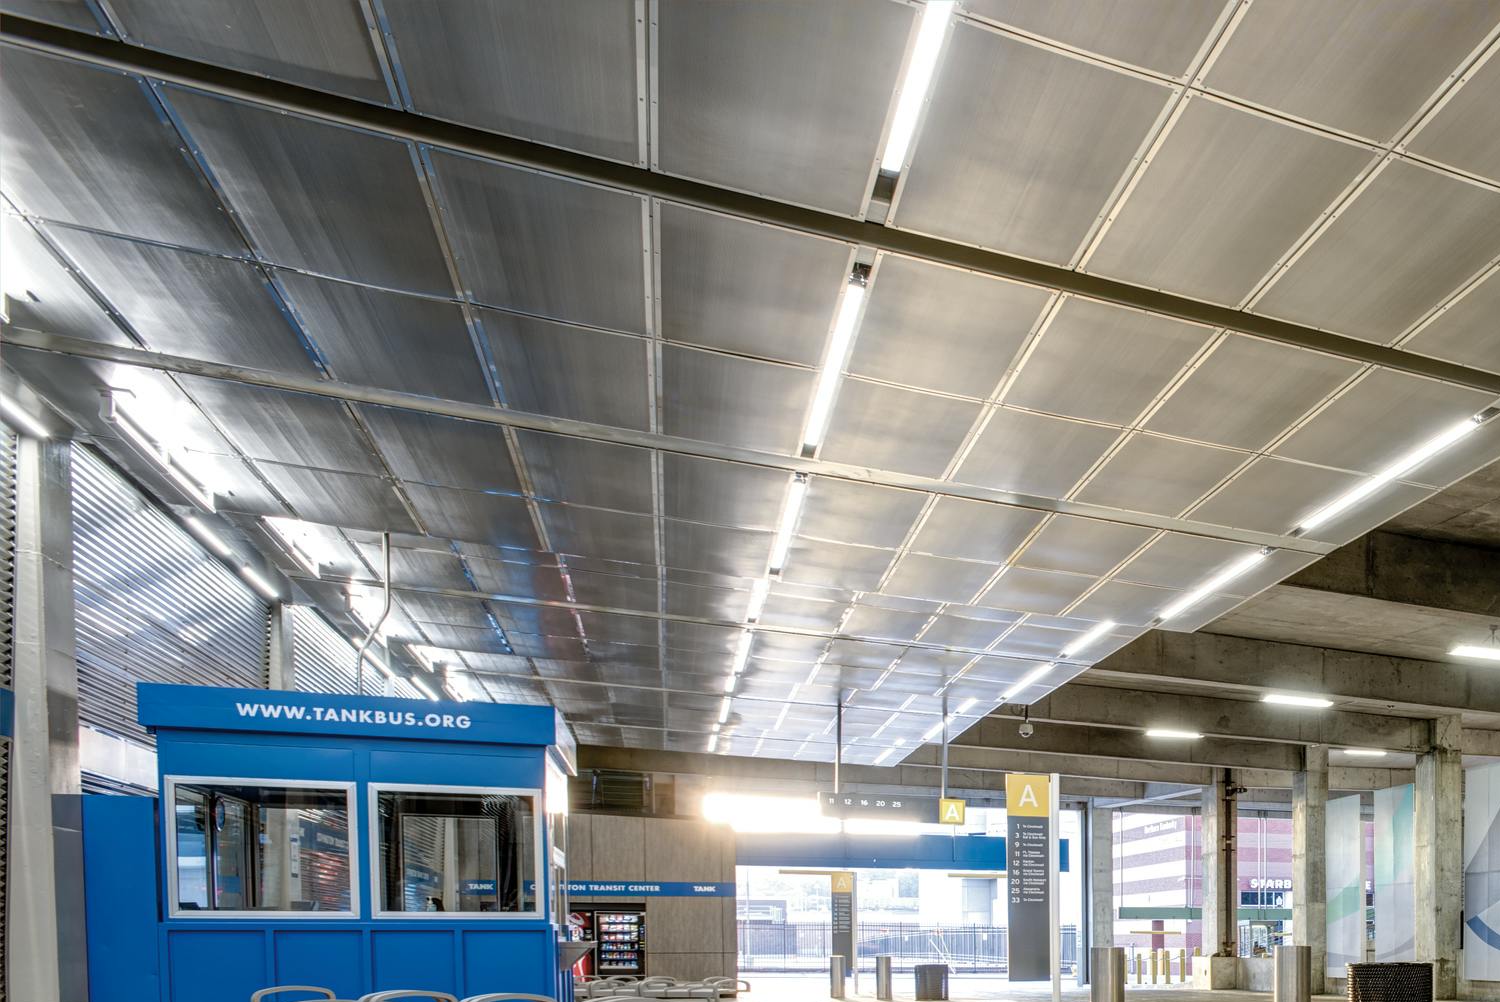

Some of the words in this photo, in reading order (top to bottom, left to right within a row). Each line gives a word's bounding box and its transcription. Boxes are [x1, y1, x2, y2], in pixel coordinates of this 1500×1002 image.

[236, 703, 471, 728] WWW.TANKBUS.ORG
[1018, 784, 1038, 807] A
[945, 803, 960, 820] A
[589, 884, 626, 892] TRANSIT
